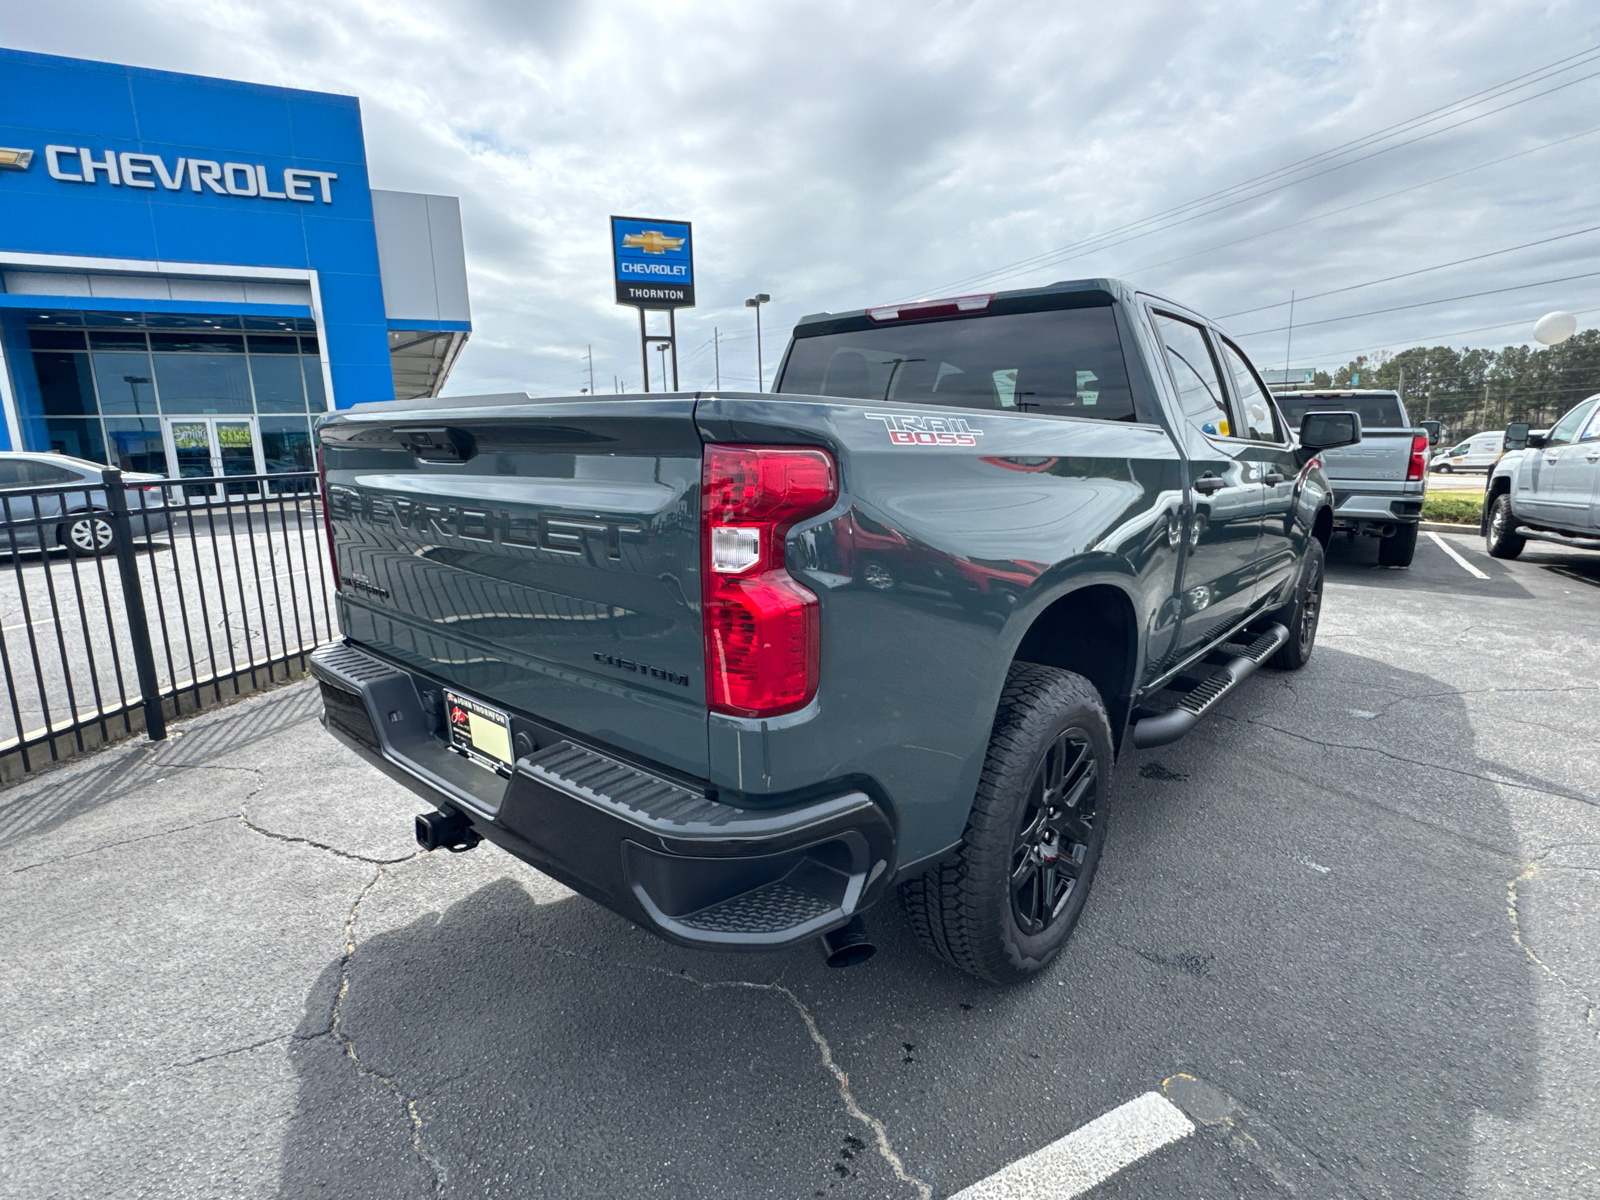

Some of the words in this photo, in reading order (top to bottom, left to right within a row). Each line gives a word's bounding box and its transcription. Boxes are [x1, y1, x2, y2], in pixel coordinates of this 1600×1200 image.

[45, 144, 338, 204] CHEVROLET
[621, 262, 687, 276] CHEVROLET
[629, 288, 684, 299] THORNTON
[864, 412, 984, 436] TRAIL
[889, 430, 976, 446] BOSS
[593, 651, 689, 687] CUSTOM
